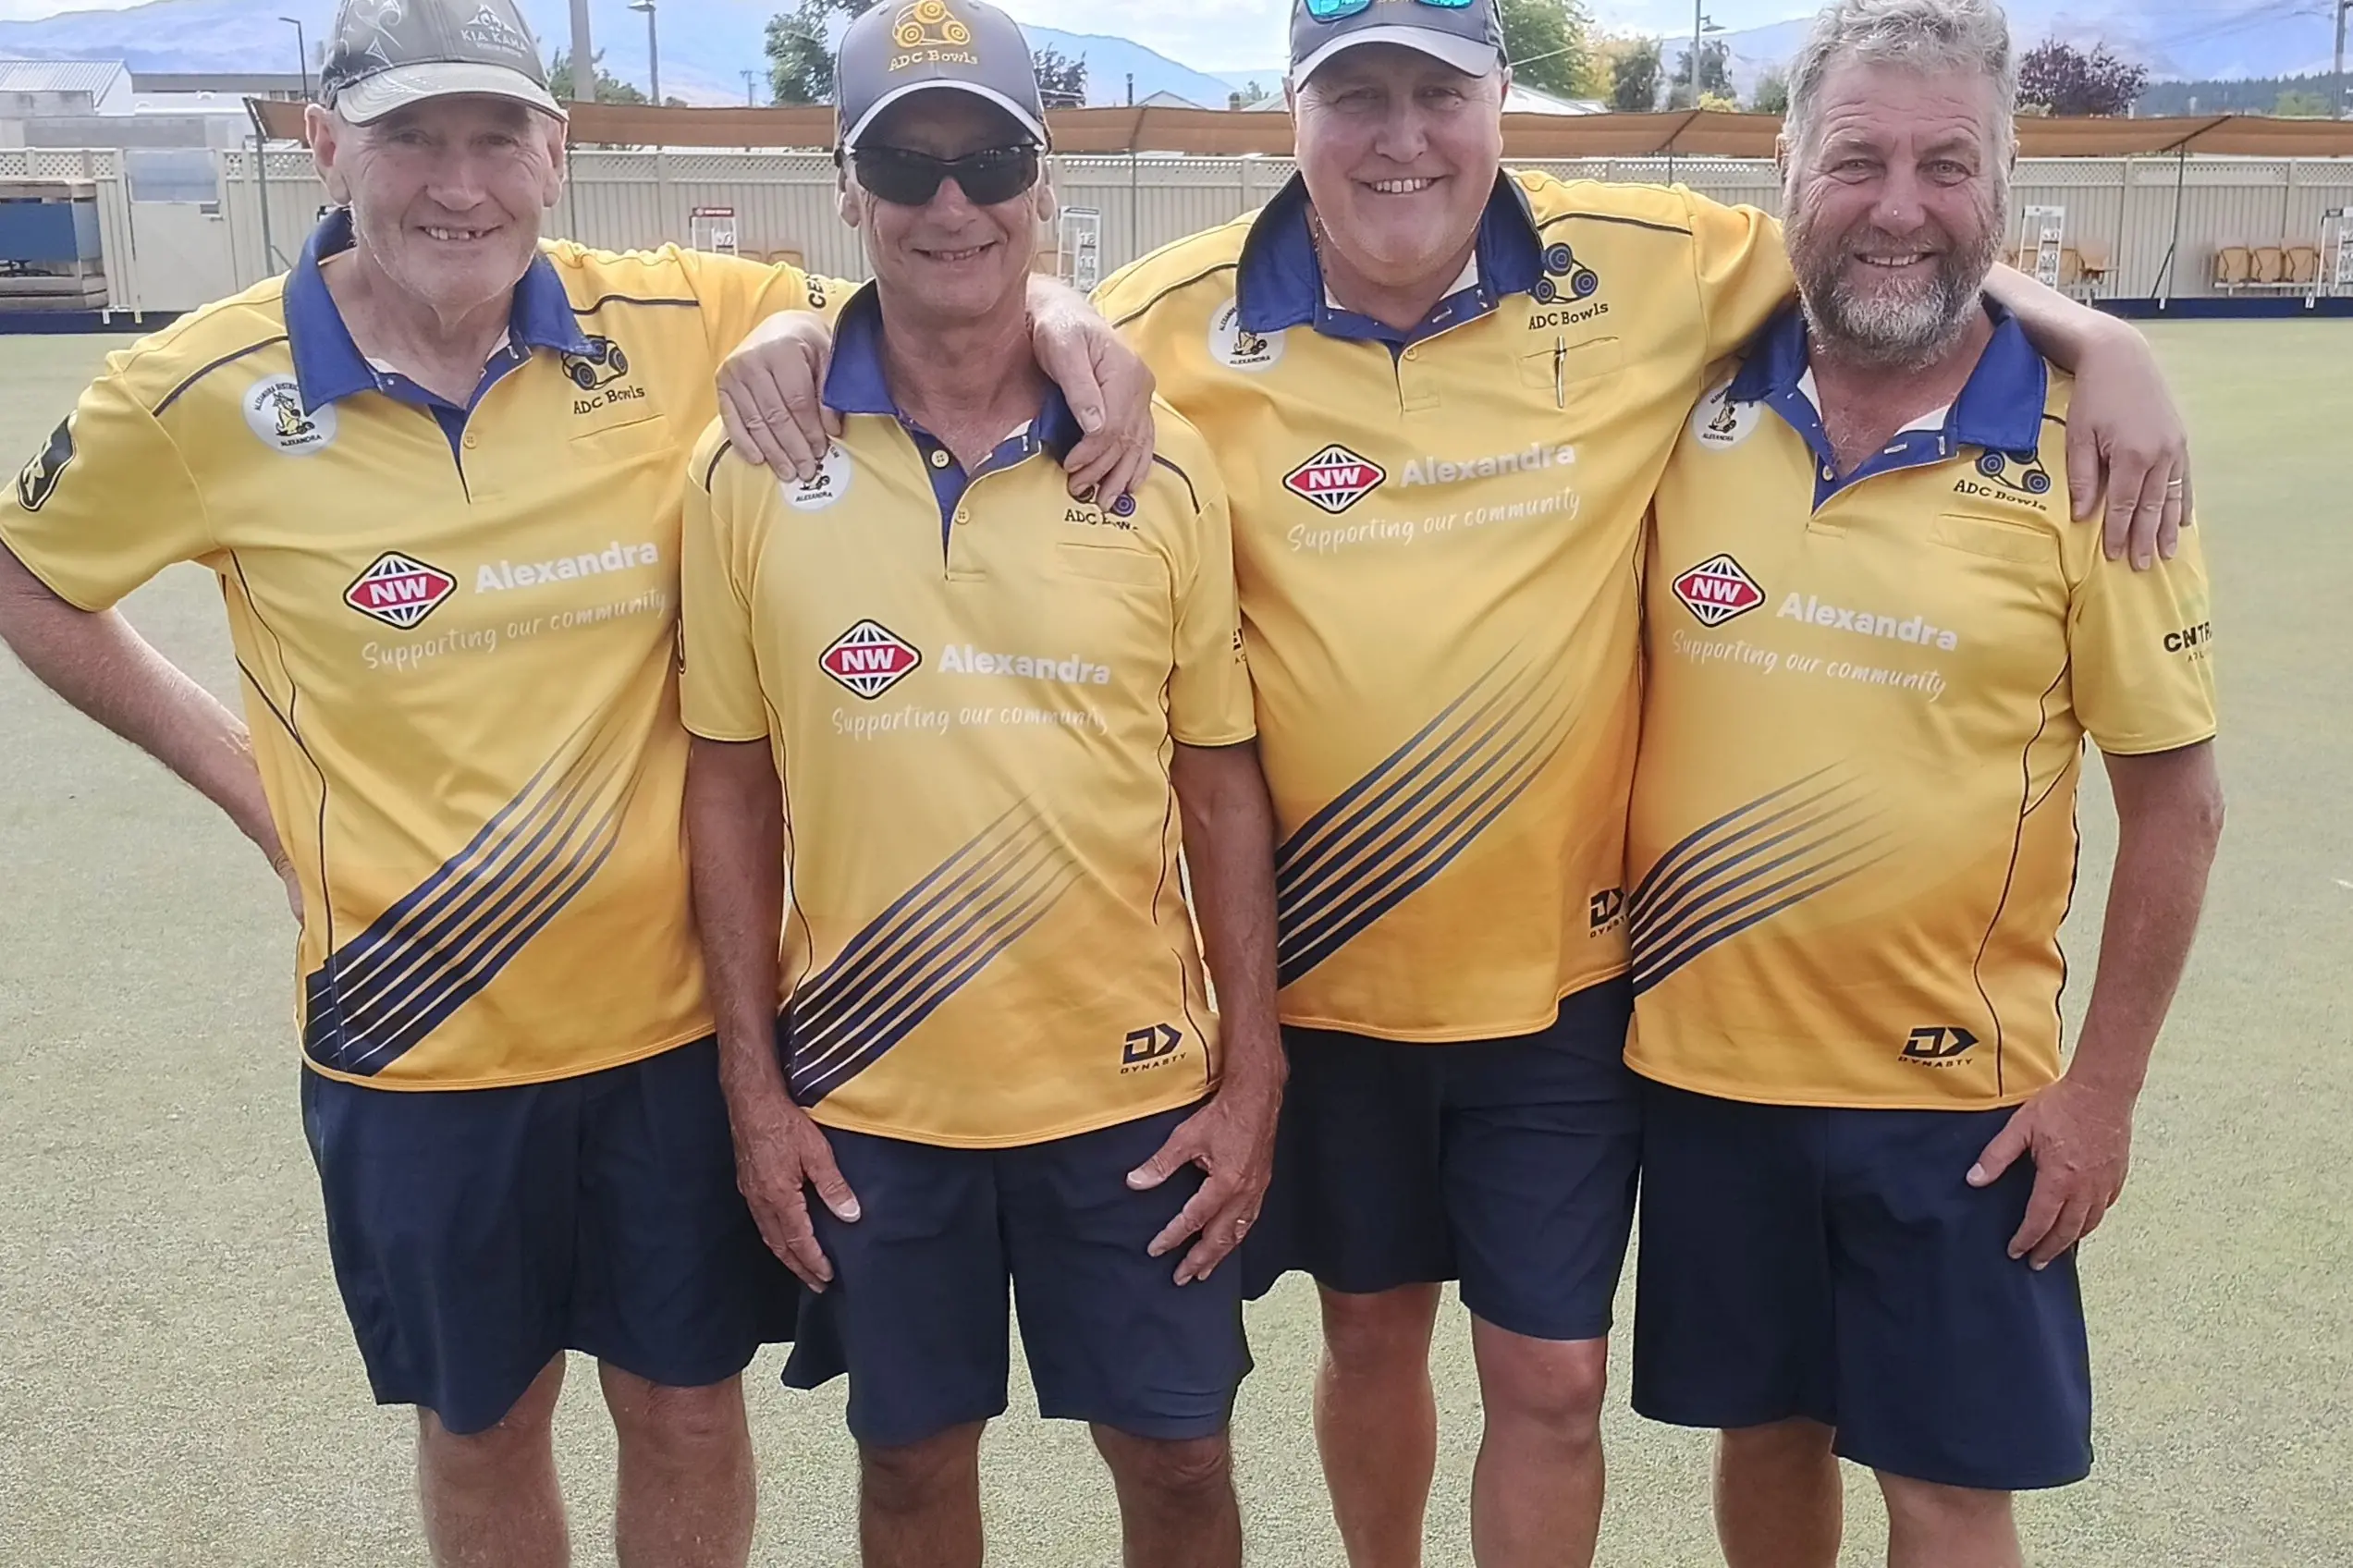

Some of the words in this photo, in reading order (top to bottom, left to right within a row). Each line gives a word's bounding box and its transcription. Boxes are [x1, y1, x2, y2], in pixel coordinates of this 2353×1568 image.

[460, 29, 488, 42] KIA
[889, 52, 924, 72] ADC
[927, 49, 978, 65] Bowls
[1528, 312, 1558, 330] ADC
[1561, 302, 1608, 325] Bowls
[574, 396, 604, 414] ADC
[605, 385, 645, 403] Bowls
[280, 435, 323, 447] ALEXANDRA
[1308, 467, 1361, 489] NW
[1400, 442, 1576, 488] Alexandra
[795, 491, 833, 502] ALEXANDRA
[1953, 479, 1992, 496] ADC
[1994, 491, 2047, 511] Bowls
[1064, 508, 1097, 525] ADC
[1287, 519, 1415, 556] Supporting
[1423, 513, 1458, 534] our
[1464, 486, 1581, 527] community
[369, 576, 428, 606] NW
[475, 540, 658, 594] Alexandra
[1691, 577, 1742, 603] NW
[1776, 592, 1958, 651] Alexandra
[362, 628, 497, 673] Supporting
[507, 617, 543, 638] our
[550, 586, 666, 631] community
[840, 647, 895, 672] NW
[938, 644, 1111, 685] Alexandra
[1671, 629, 1779, 675] Supporting
[1785, 653, 1823, 674] our
[1826, 659, 1947, 703] community
[832, 704, 950, 741] Supporting
[959, 706, 994, 726] our
[1120, 1051, 1187, 1074] DYNASTY
[1897, 1056, 1973, 1068] DYNASTY
